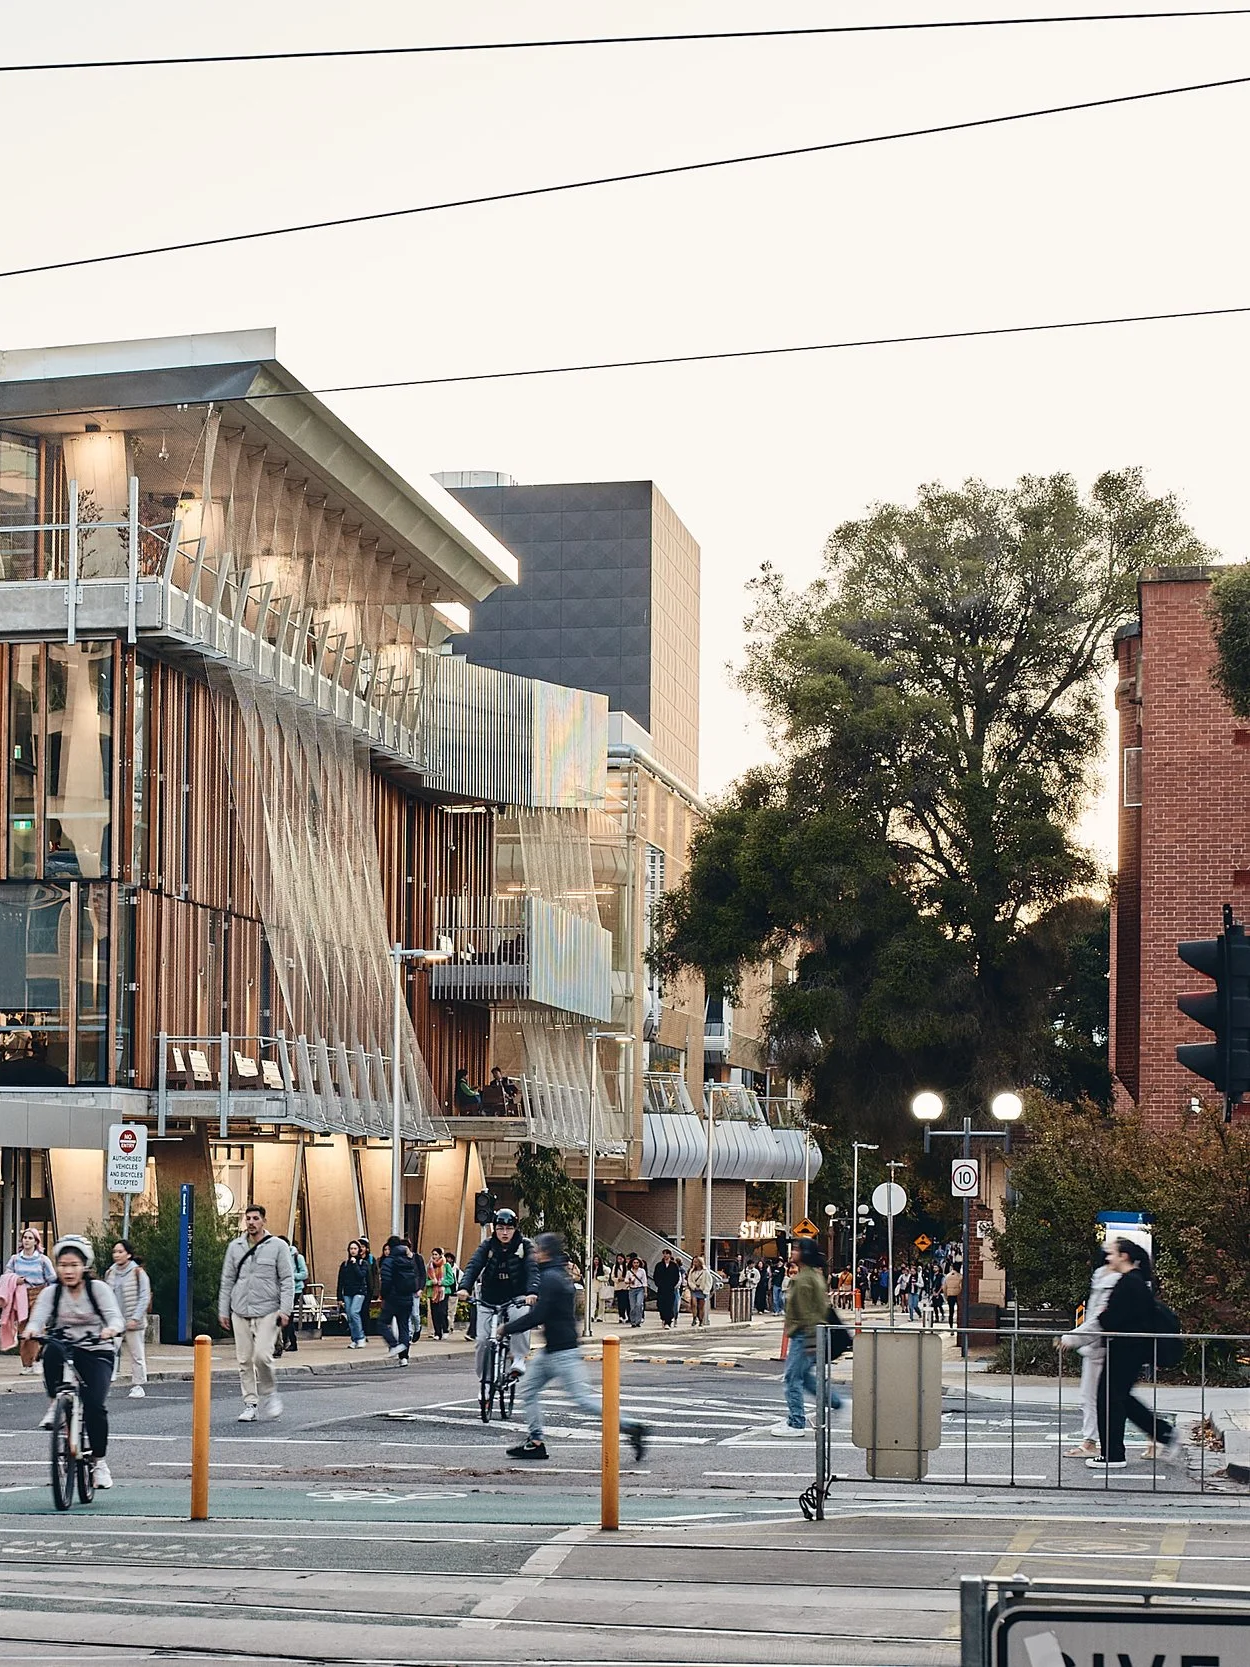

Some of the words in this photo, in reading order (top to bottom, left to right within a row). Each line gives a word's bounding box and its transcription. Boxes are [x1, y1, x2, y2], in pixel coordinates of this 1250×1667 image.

[112, 1155, 142, 1163] AUTHORISED
[120, 1171, 143, 1179] BICYCLES
[958, 1171, 972, 1185] 10
[114, 1179, 139, 1187] EXCEPTED
